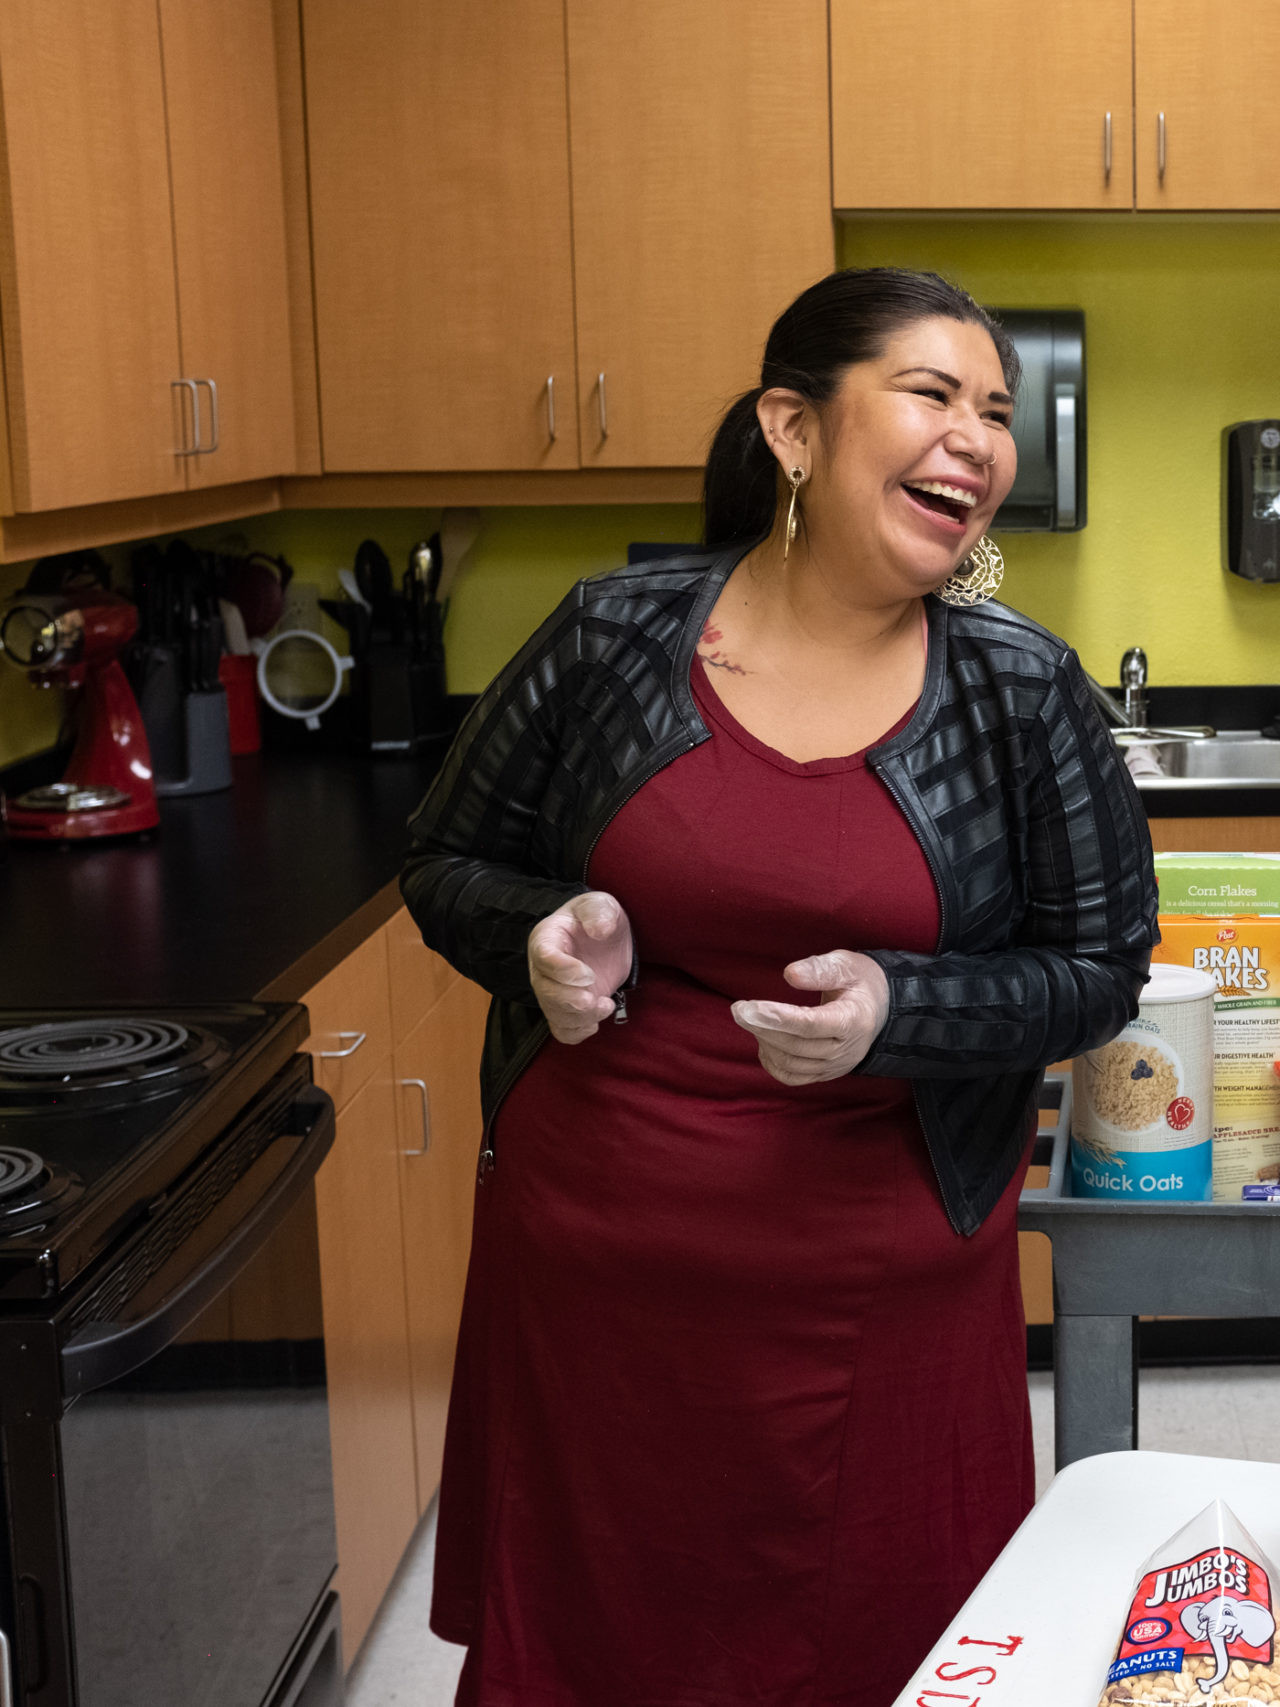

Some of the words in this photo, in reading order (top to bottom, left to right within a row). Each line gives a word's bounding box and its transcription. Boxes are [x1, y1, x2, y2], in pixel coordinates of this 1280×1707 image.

[1188, 886, 1217, 896] Corn
[1220, 885, 1257, 896] Flakes
[1218, 930, 1235, 942] Post
[1194, 947, 1259, 968] BRAN
[1212, 967, 1267, 990] AKES
[1083, 1168, 1134, 1192] Quick
[1140, 1174, 1184, 1192] Oats
[1133, 1626, 1162, 1638] USA
[1110, 1650, 1178, 1674] EANUTS
